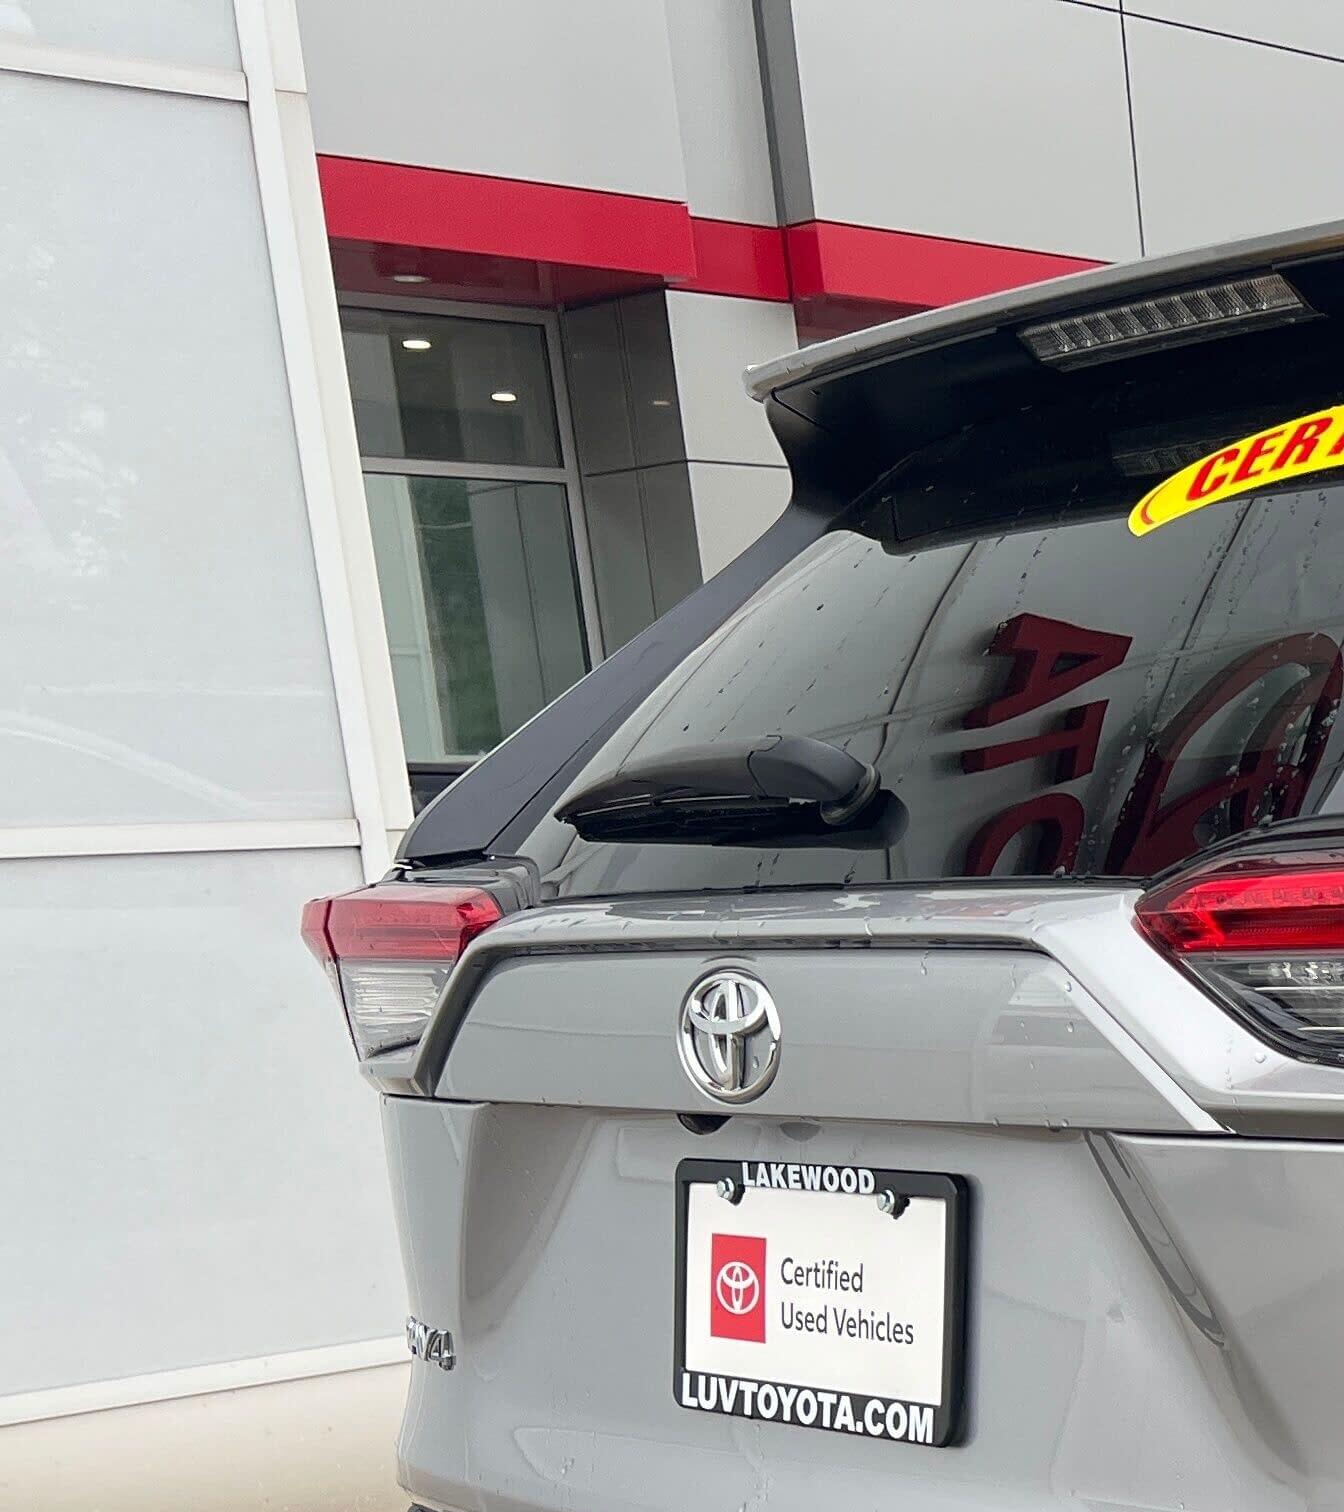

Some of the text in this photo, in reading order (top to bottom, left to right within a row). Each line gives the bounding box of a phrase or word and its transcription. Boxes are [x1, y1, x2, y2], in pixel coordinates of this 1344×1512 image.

[742, 1161, 876, 1195] LAKEWOOD
[780, 1256, 864, 1293] Certified
[781, 1301, 915, 1346] Used Vehicles
[681, 1372, 934, 1445] LUVTOYOTA.COM
